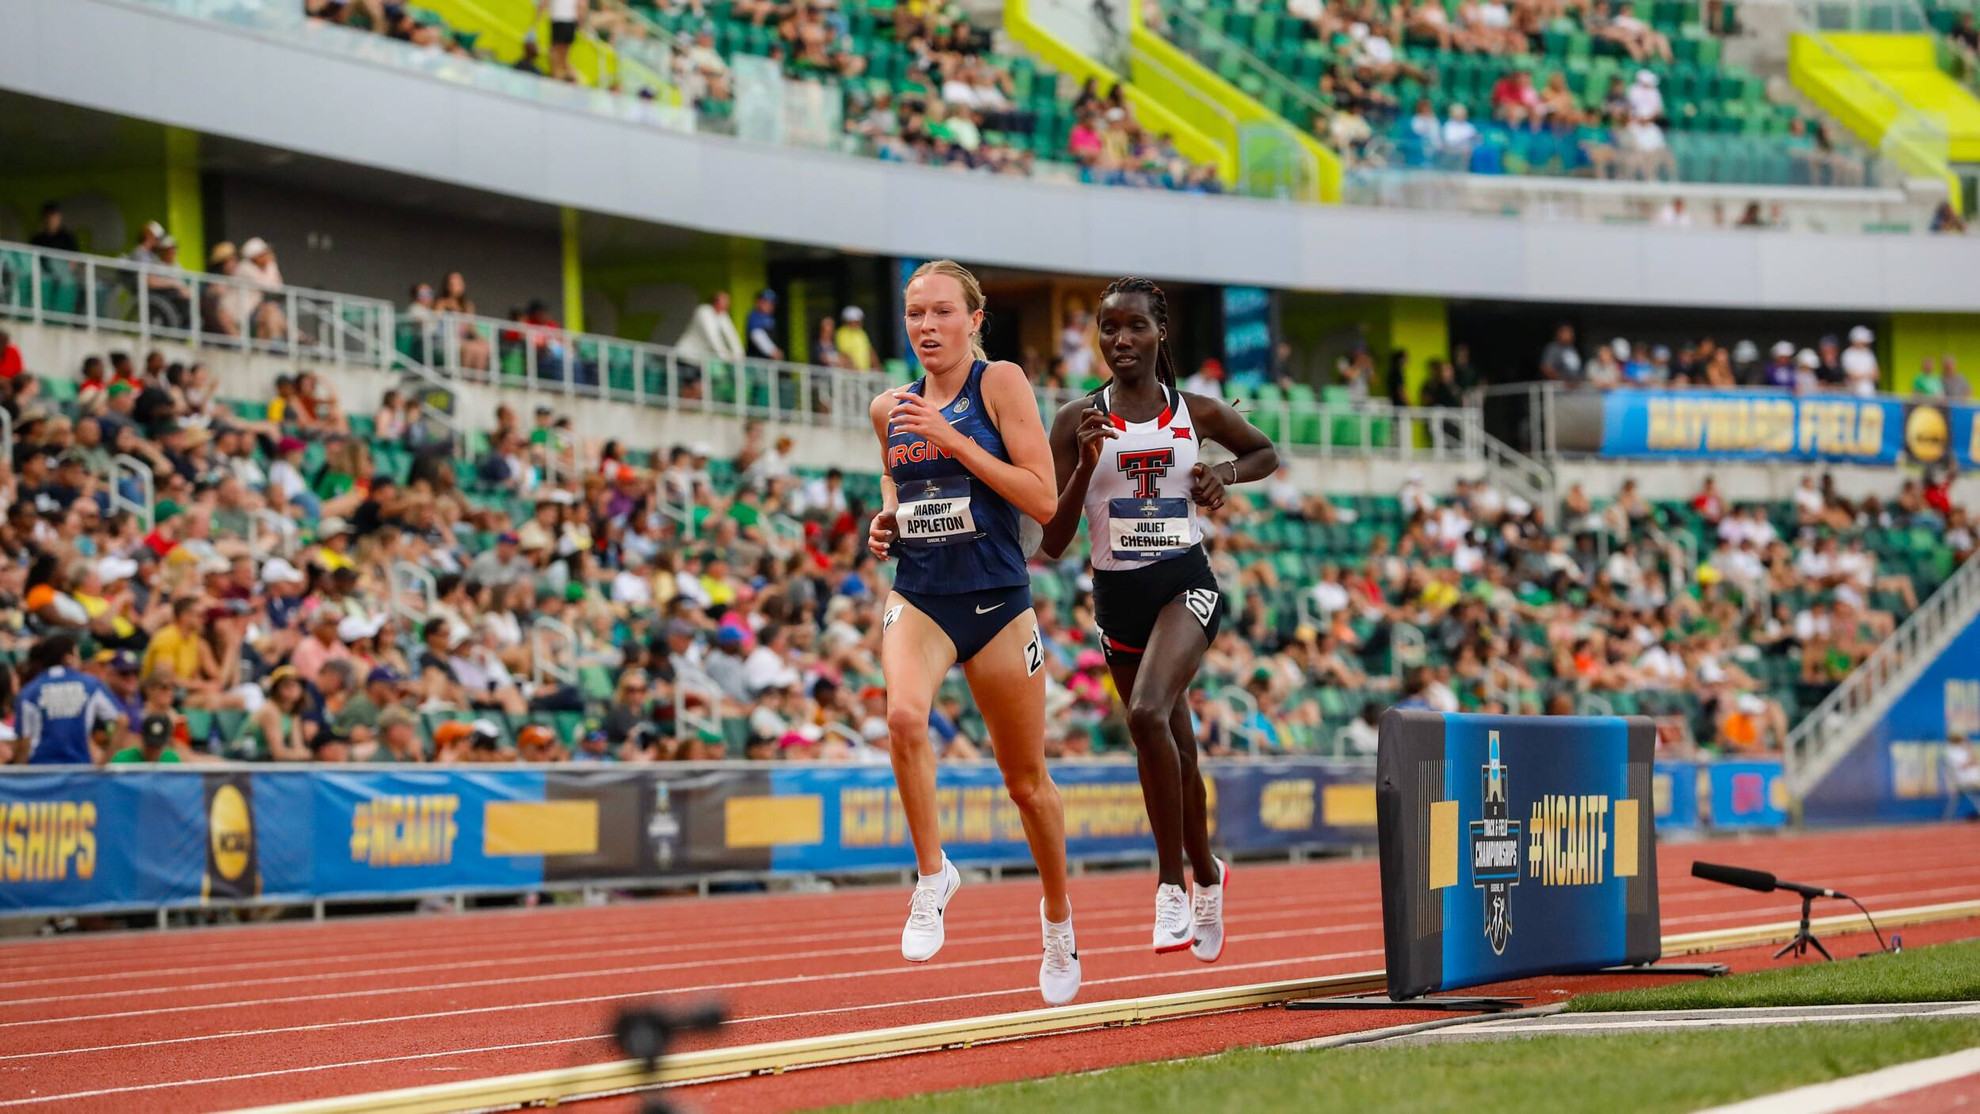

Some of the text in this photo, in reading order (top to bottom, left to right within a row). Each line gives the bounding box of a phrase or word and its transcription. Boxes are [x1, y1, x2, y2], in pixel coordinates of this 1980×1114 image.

[1801, 402, 1884, 456] FIELD
[914, 503, 952, 517] MARGOT
[907, 516, 965, 534] APPLETON
[1134, 522, 1166, 533] JULIET
[1120, 535, 1181, 547] CHERUBET
[1529, 794, 1608, 886] #NCAATF
[1475, 840, 1517, 868] CHAMPIONSHIPS
